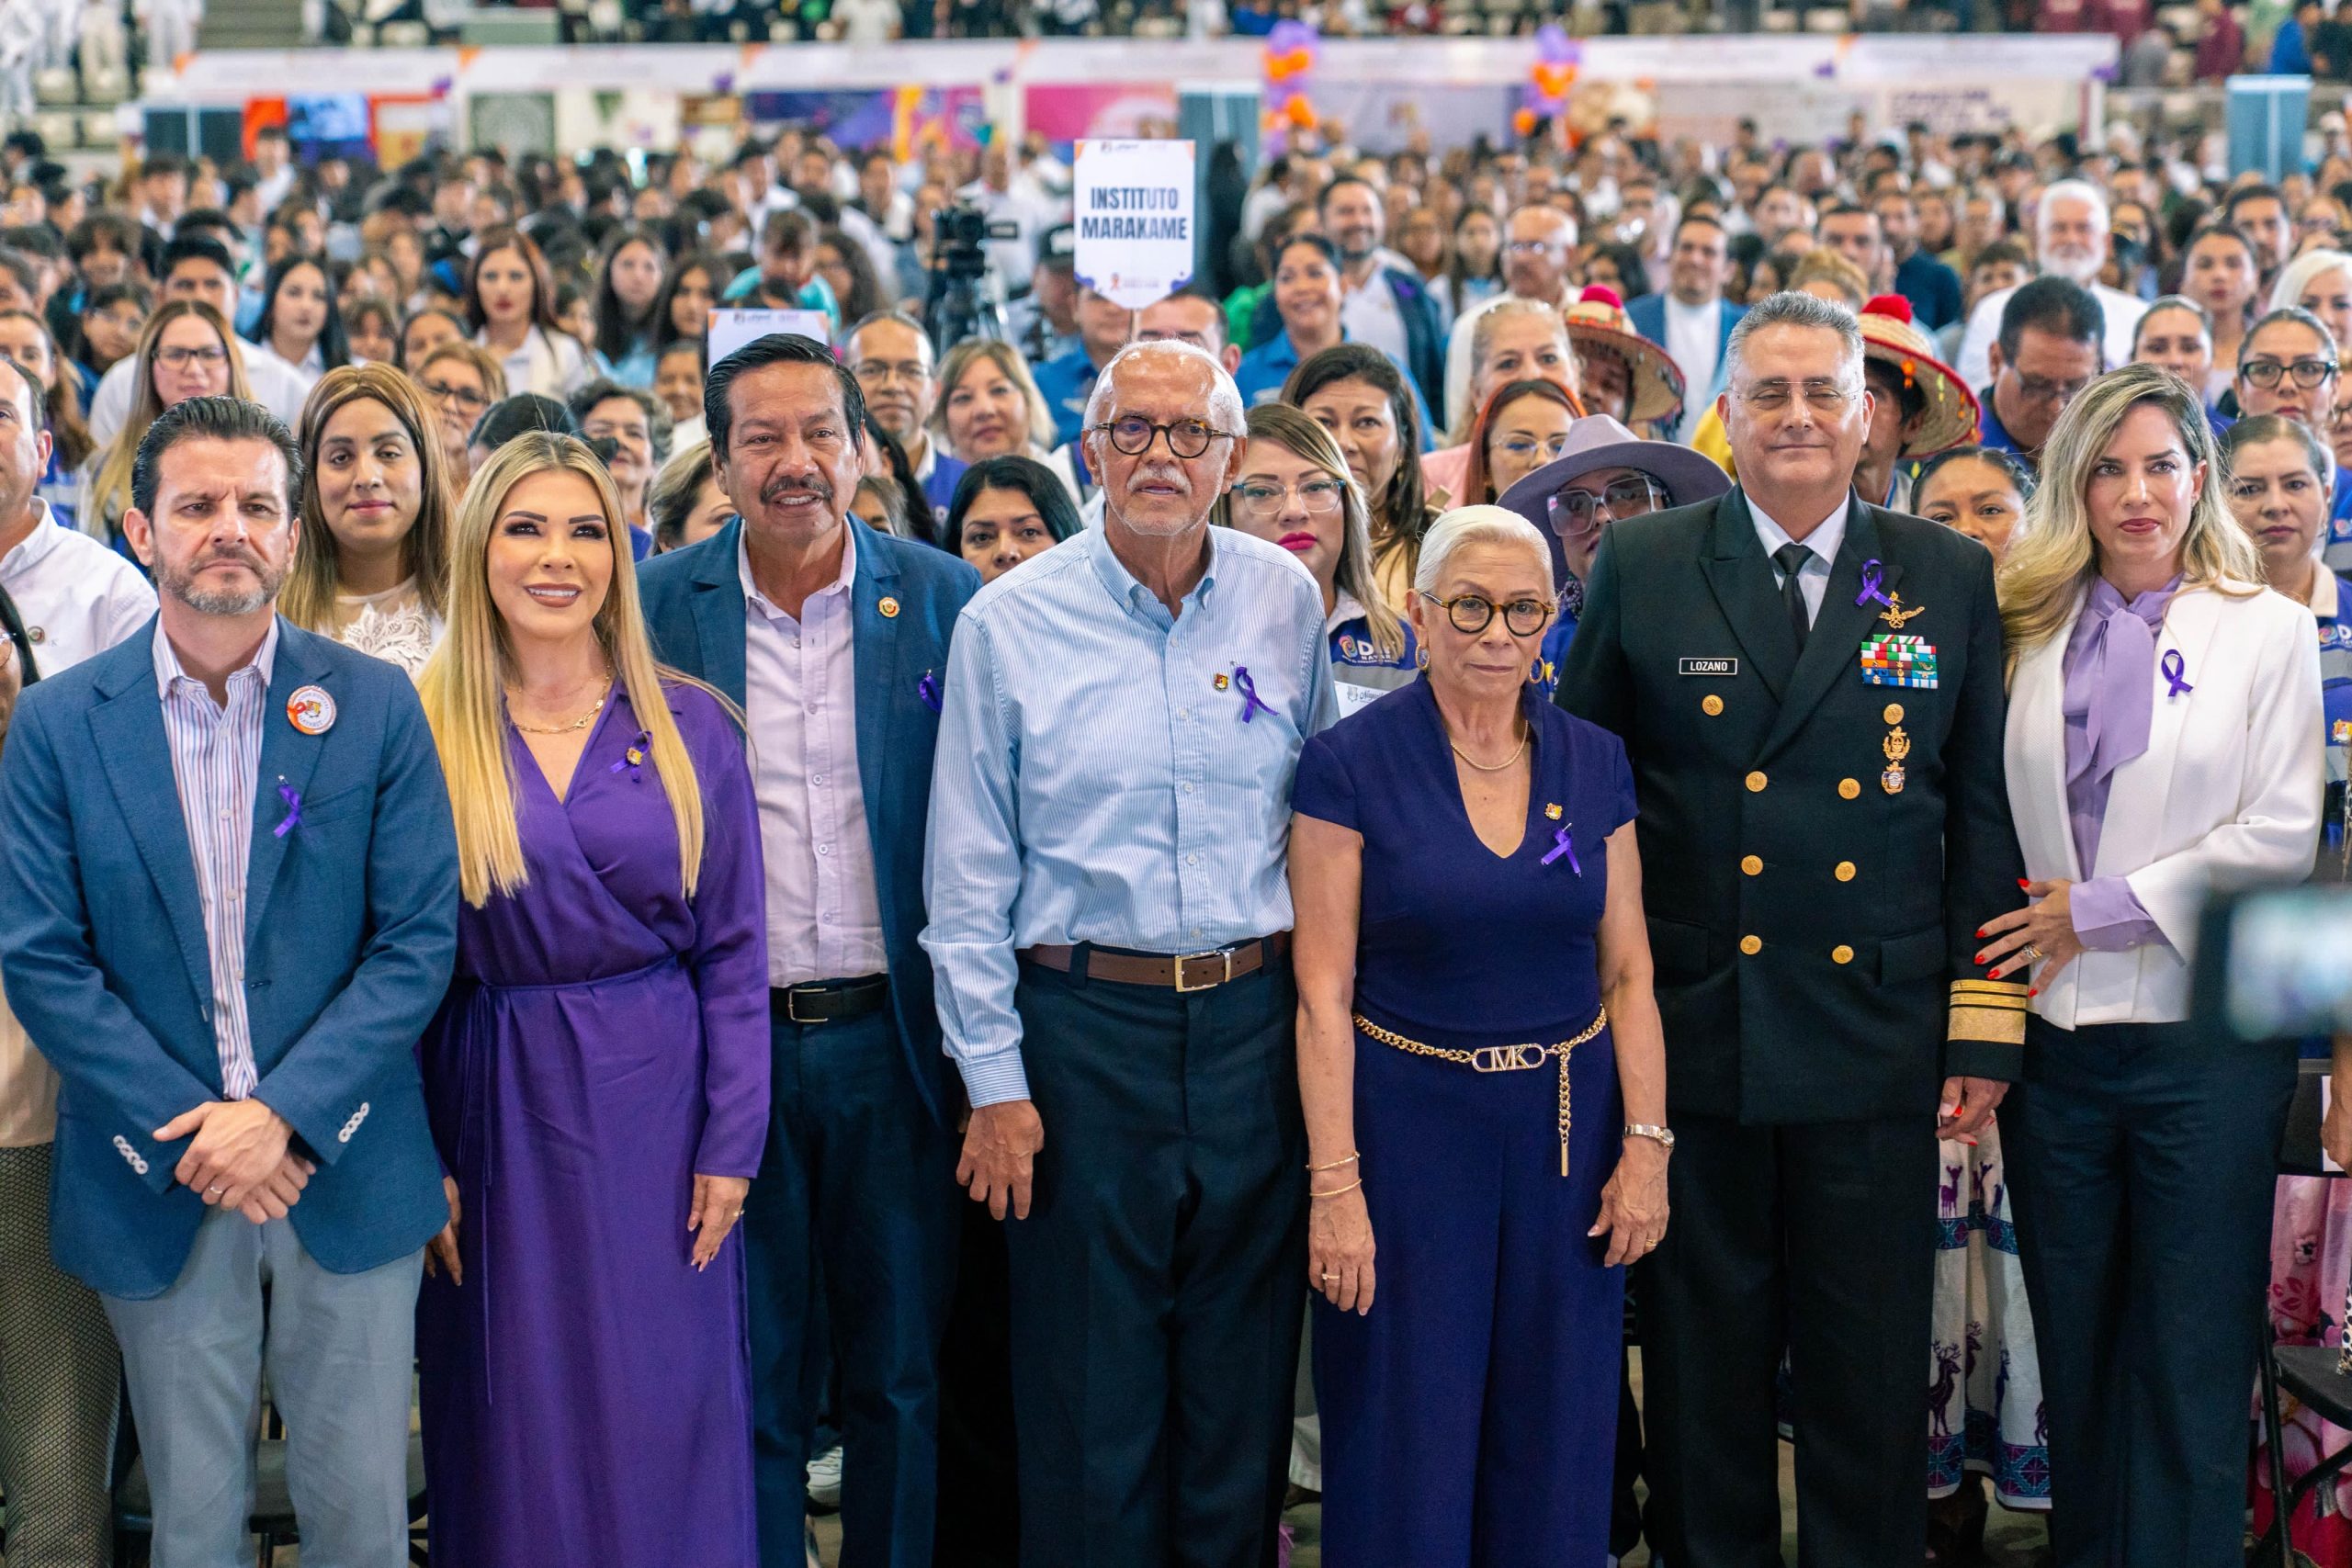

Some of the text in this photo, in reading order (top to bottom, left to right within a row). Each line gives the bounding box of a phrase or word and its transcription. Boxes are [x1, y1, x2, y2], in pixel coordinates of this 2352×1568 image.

[1091, 186, 1179, 210] INSTITUTO
[1081, 216, 1188, 241] MARAKAME
[1690, 660, 1728, 671] LOZANO
[1489, 1043, 1531, 1071] MK
